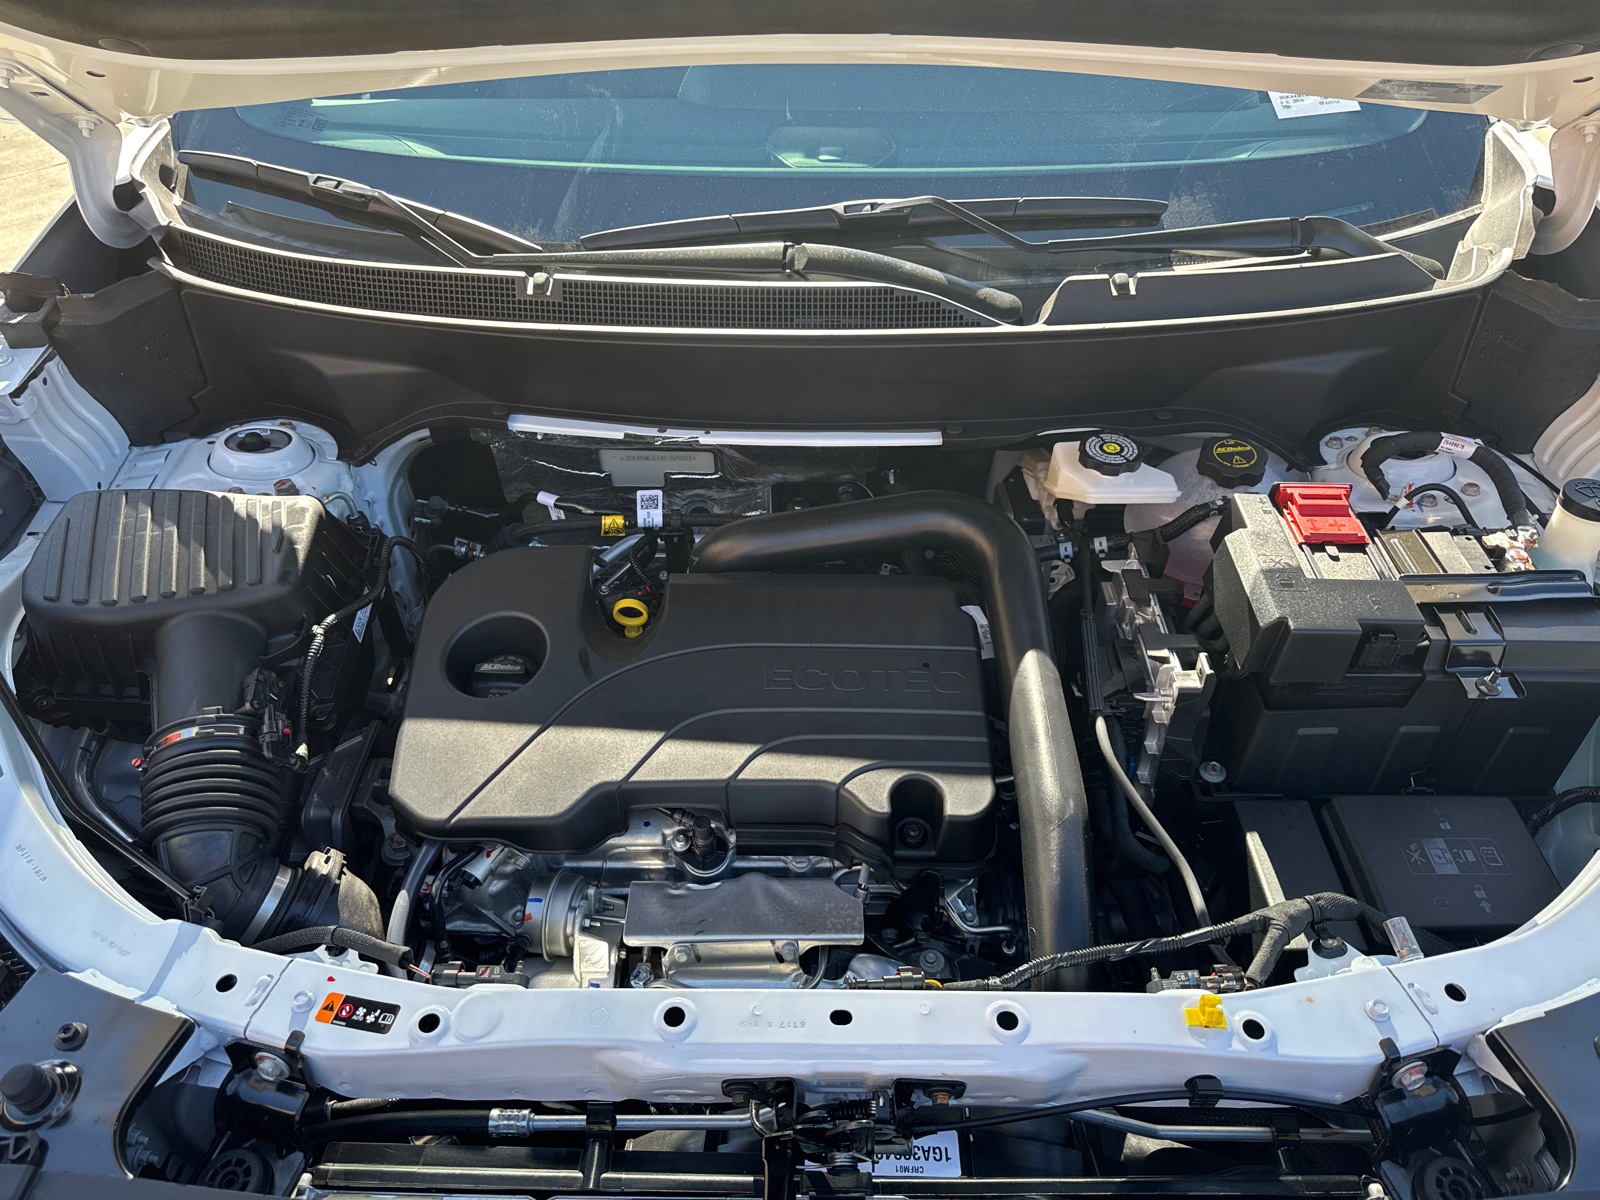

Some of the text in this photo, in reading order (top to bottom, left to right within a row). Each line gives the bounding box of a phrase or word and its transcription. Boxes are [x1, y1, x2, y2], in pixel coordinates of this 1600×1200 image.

[480, 663, 521, 671] ACDelco
[763, 665, 968, 693] ECOTEC
[895, 1165, 924, 1174] CRFM01
